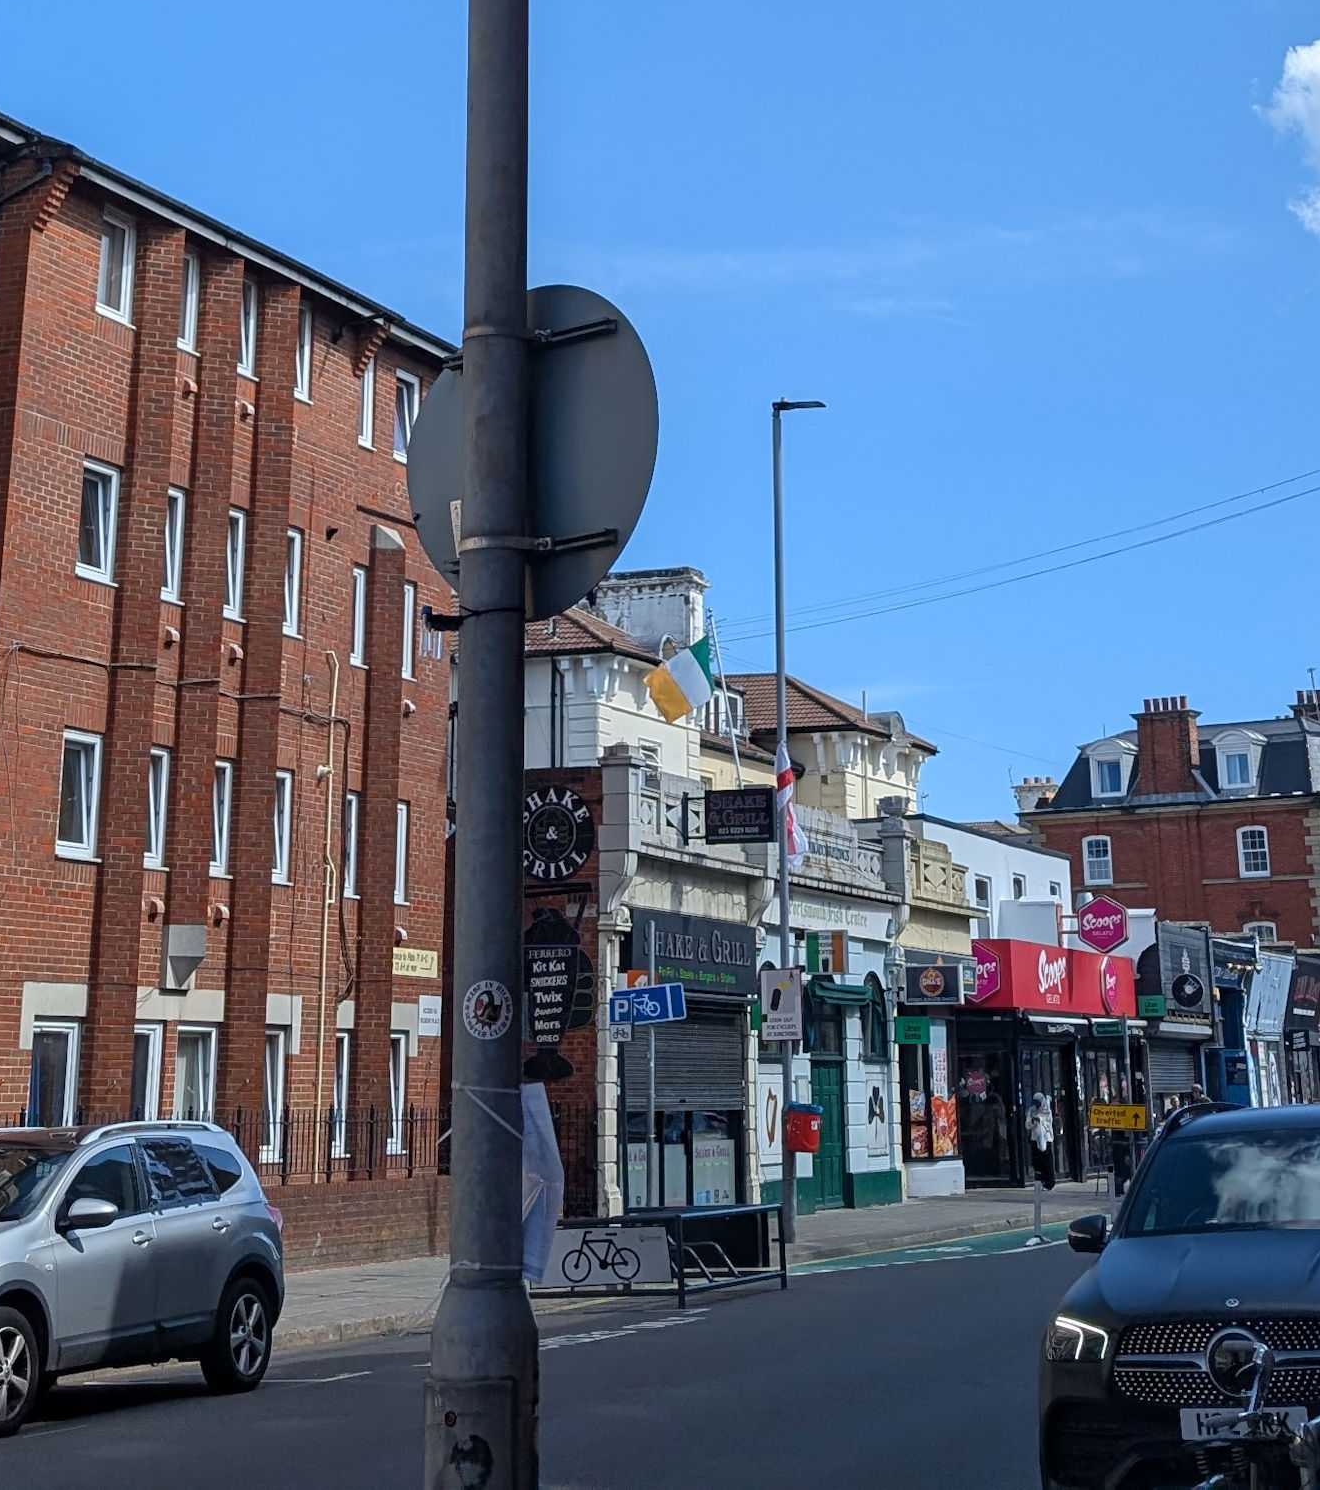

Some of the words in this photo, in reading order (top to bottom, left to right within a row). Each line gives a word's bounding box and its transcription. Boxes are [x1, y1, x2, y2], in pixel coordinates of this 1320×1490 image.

[709, 793, 767, 810] SHAKE
[722, 810, 770, 826] GRILL
[546, 826, 558, 840] &
[1082, 913, 1122, 931] Scoops
[529, 948, 571, 959] FERRERO
[698, 937, 708, 962] &
[711, 930, 751, 966] GRILL
[533, 961, 547, 973] Kit
[548, 960, 566, 972] Kat
[977, 962, 996, 979] ops
[1038, 950, 1067, 994] Scoops
[530, 975, 568, 988] SNICKERS
[534, 991, 563, 1003] Twix
[534, 1007, 562, 1017] bueno
[614, 1000, 629, 1021] P
[534, 1020, 561, 1030] Mars
[536, 1035, 559, 1043] OREO
[1093, 1109, 1126, 1117] Diverted
[1096, 1116, 1122, 1125] traffic
